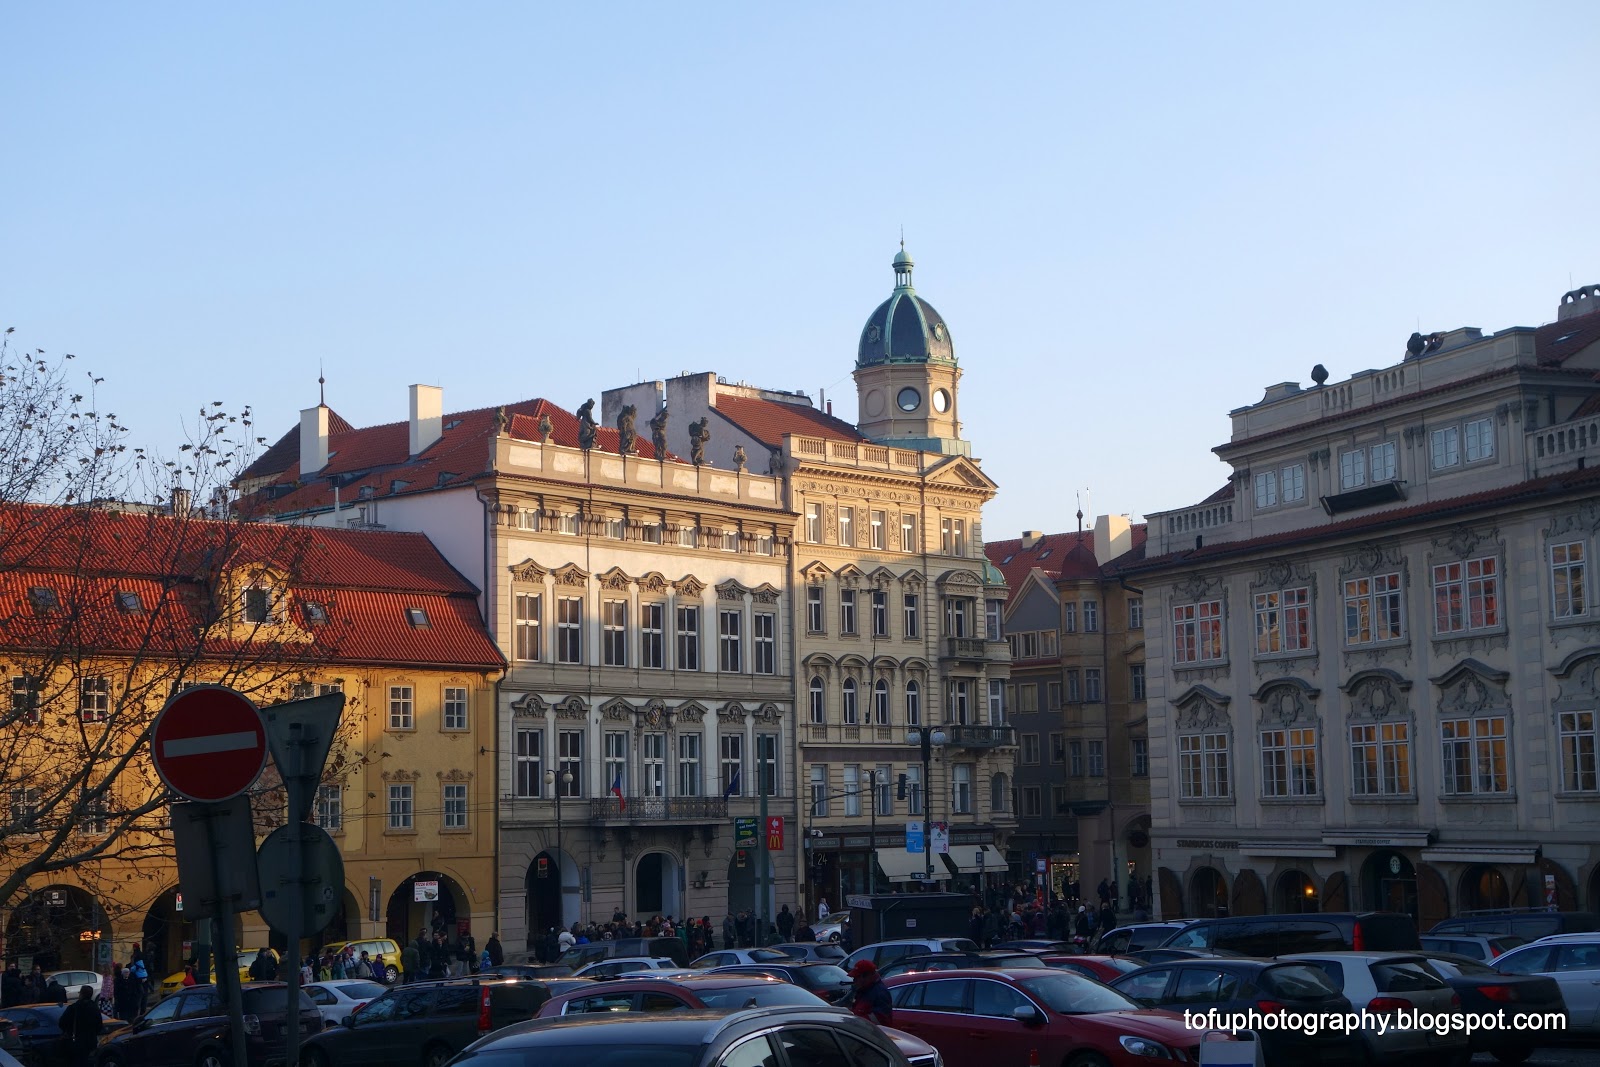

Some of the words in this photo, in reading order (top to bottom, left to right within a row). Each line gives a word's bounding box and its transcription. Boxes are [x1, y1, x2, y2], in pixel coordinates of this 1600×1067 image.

[1176, 839, 1214, 848] STARBUCKS
[1214, 840, 1239, 849] COFFEE
[817, 853, 828, 866] 24
